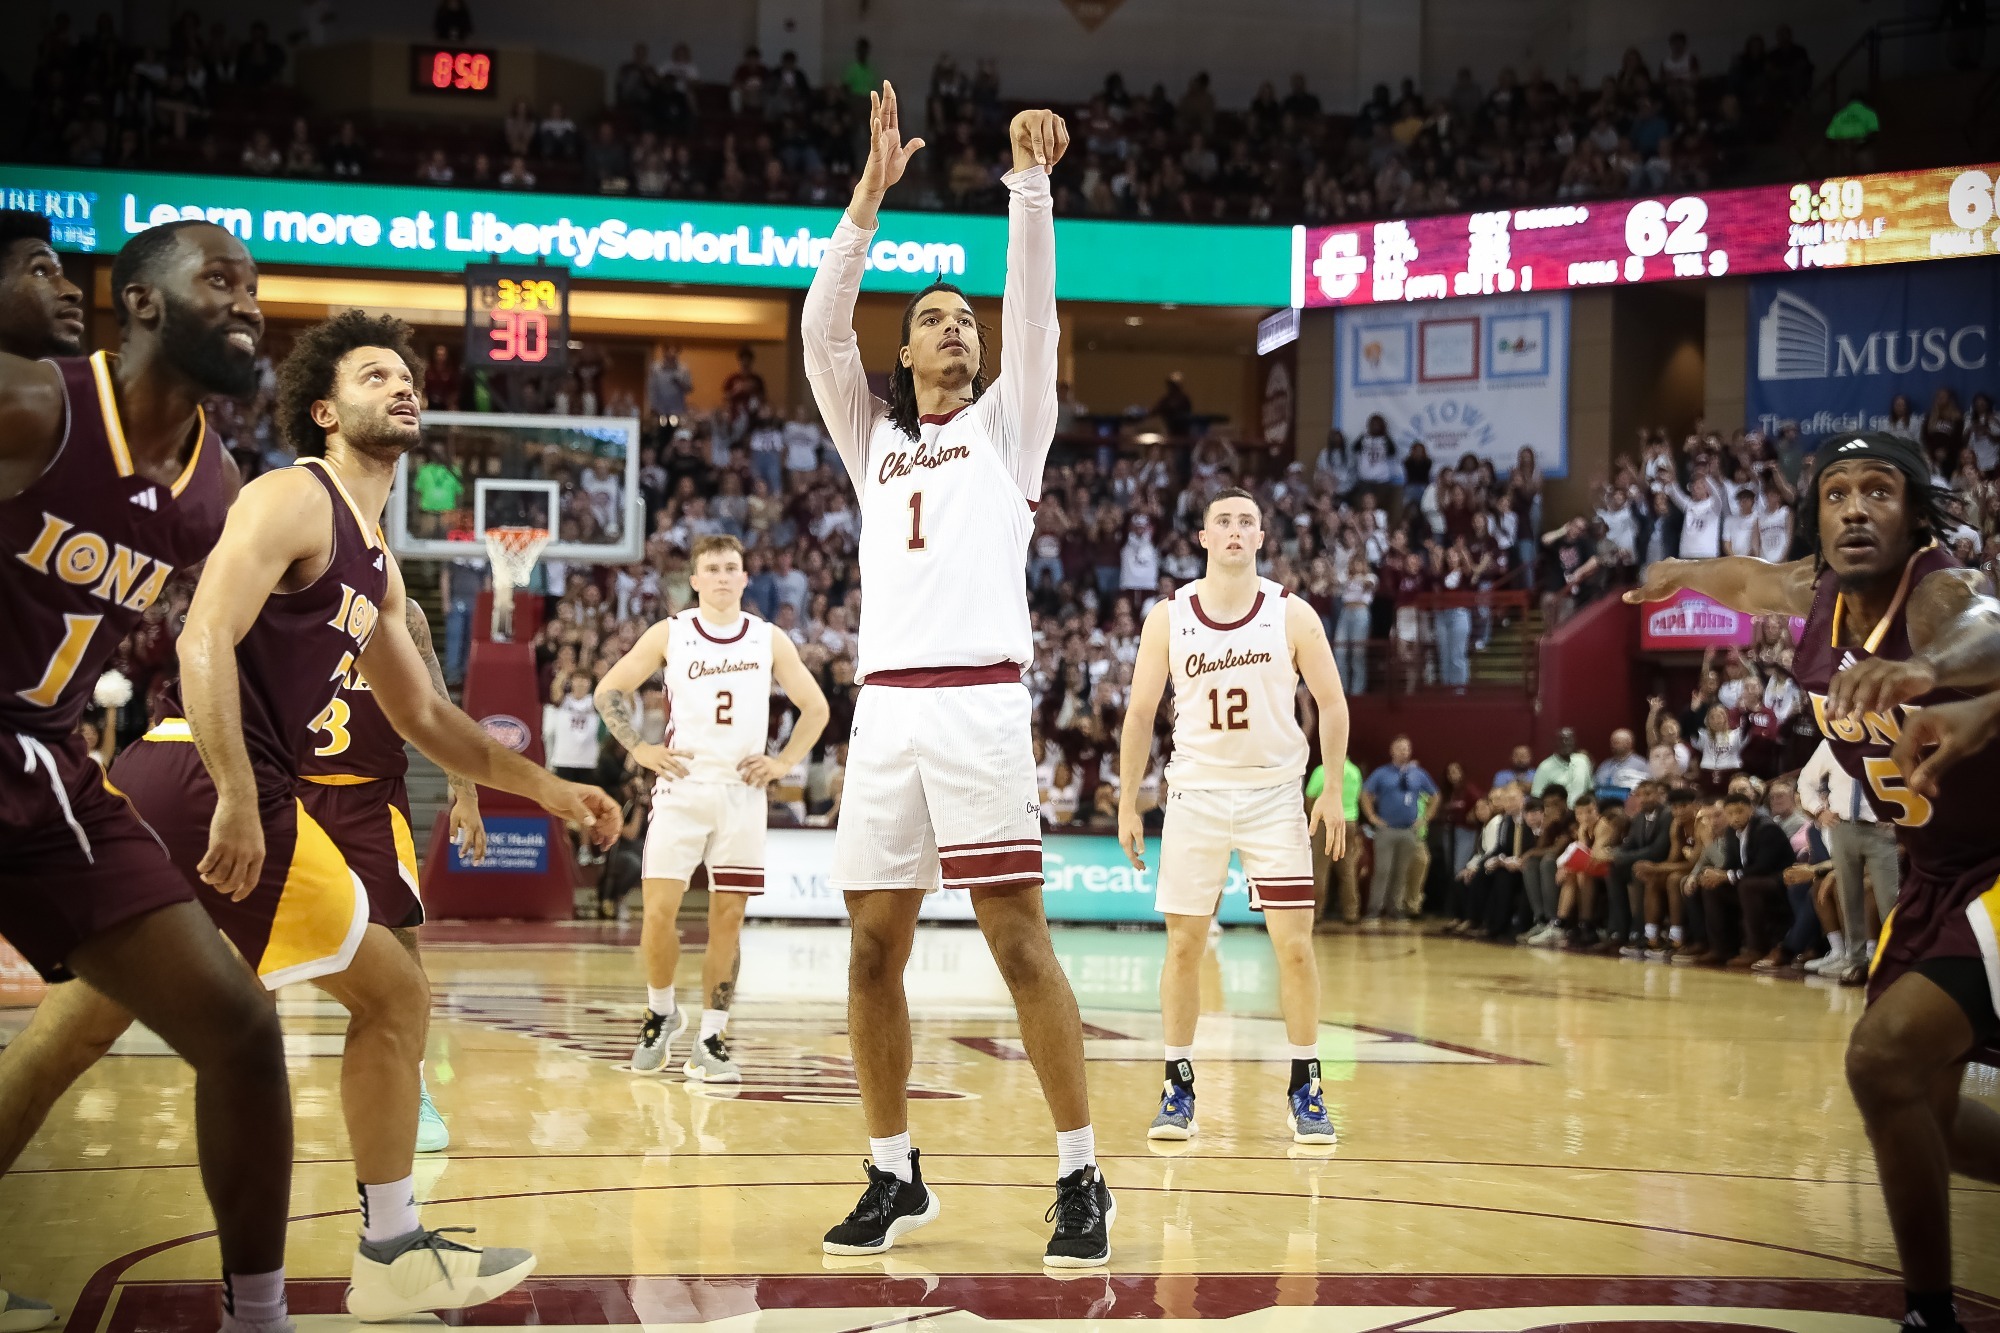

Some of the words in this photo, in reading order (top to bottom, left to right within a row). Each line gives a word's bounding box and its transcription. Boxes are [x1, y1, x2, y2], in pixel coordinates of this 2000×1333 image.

[1788, 179, 1865, 225] 3:39
[1948, 170, 2000, 230] 6
[122, 192, 253, 241] Learn
[262, 208, 382, 247] more
[389, 209, 436, 250] at
[444, 211, 965, 276] LibertySeniorLivin.com
[1624, 196, 1708, 257] 62
[1823, 216, 1887, 243] HALF
[498, 278, 556, 311] 3:39
[489, 311, 548, 362] 30
[1833, 324, 1987, 378] MUSC
[1801, 409, 1865, 435] official
[878, 442, 971, 485] Chaleston
[906, 489, 928, 552] 1
[15, 511, 175, 613] IONA
[326, 582, 380, 656] ION
[15, 612, 105, 707] 1
[688, 658, 760, 681] Charleston
[1185, 647, 1272, 679] Charleston
[715, 690, 734, 726] 2
[1207, 687, 1250, 732] 12
[1808, 690, 1922, 747] ION
[1861, 756, 1934, 828] 5
[1041, 852, 1153, 894] Great
